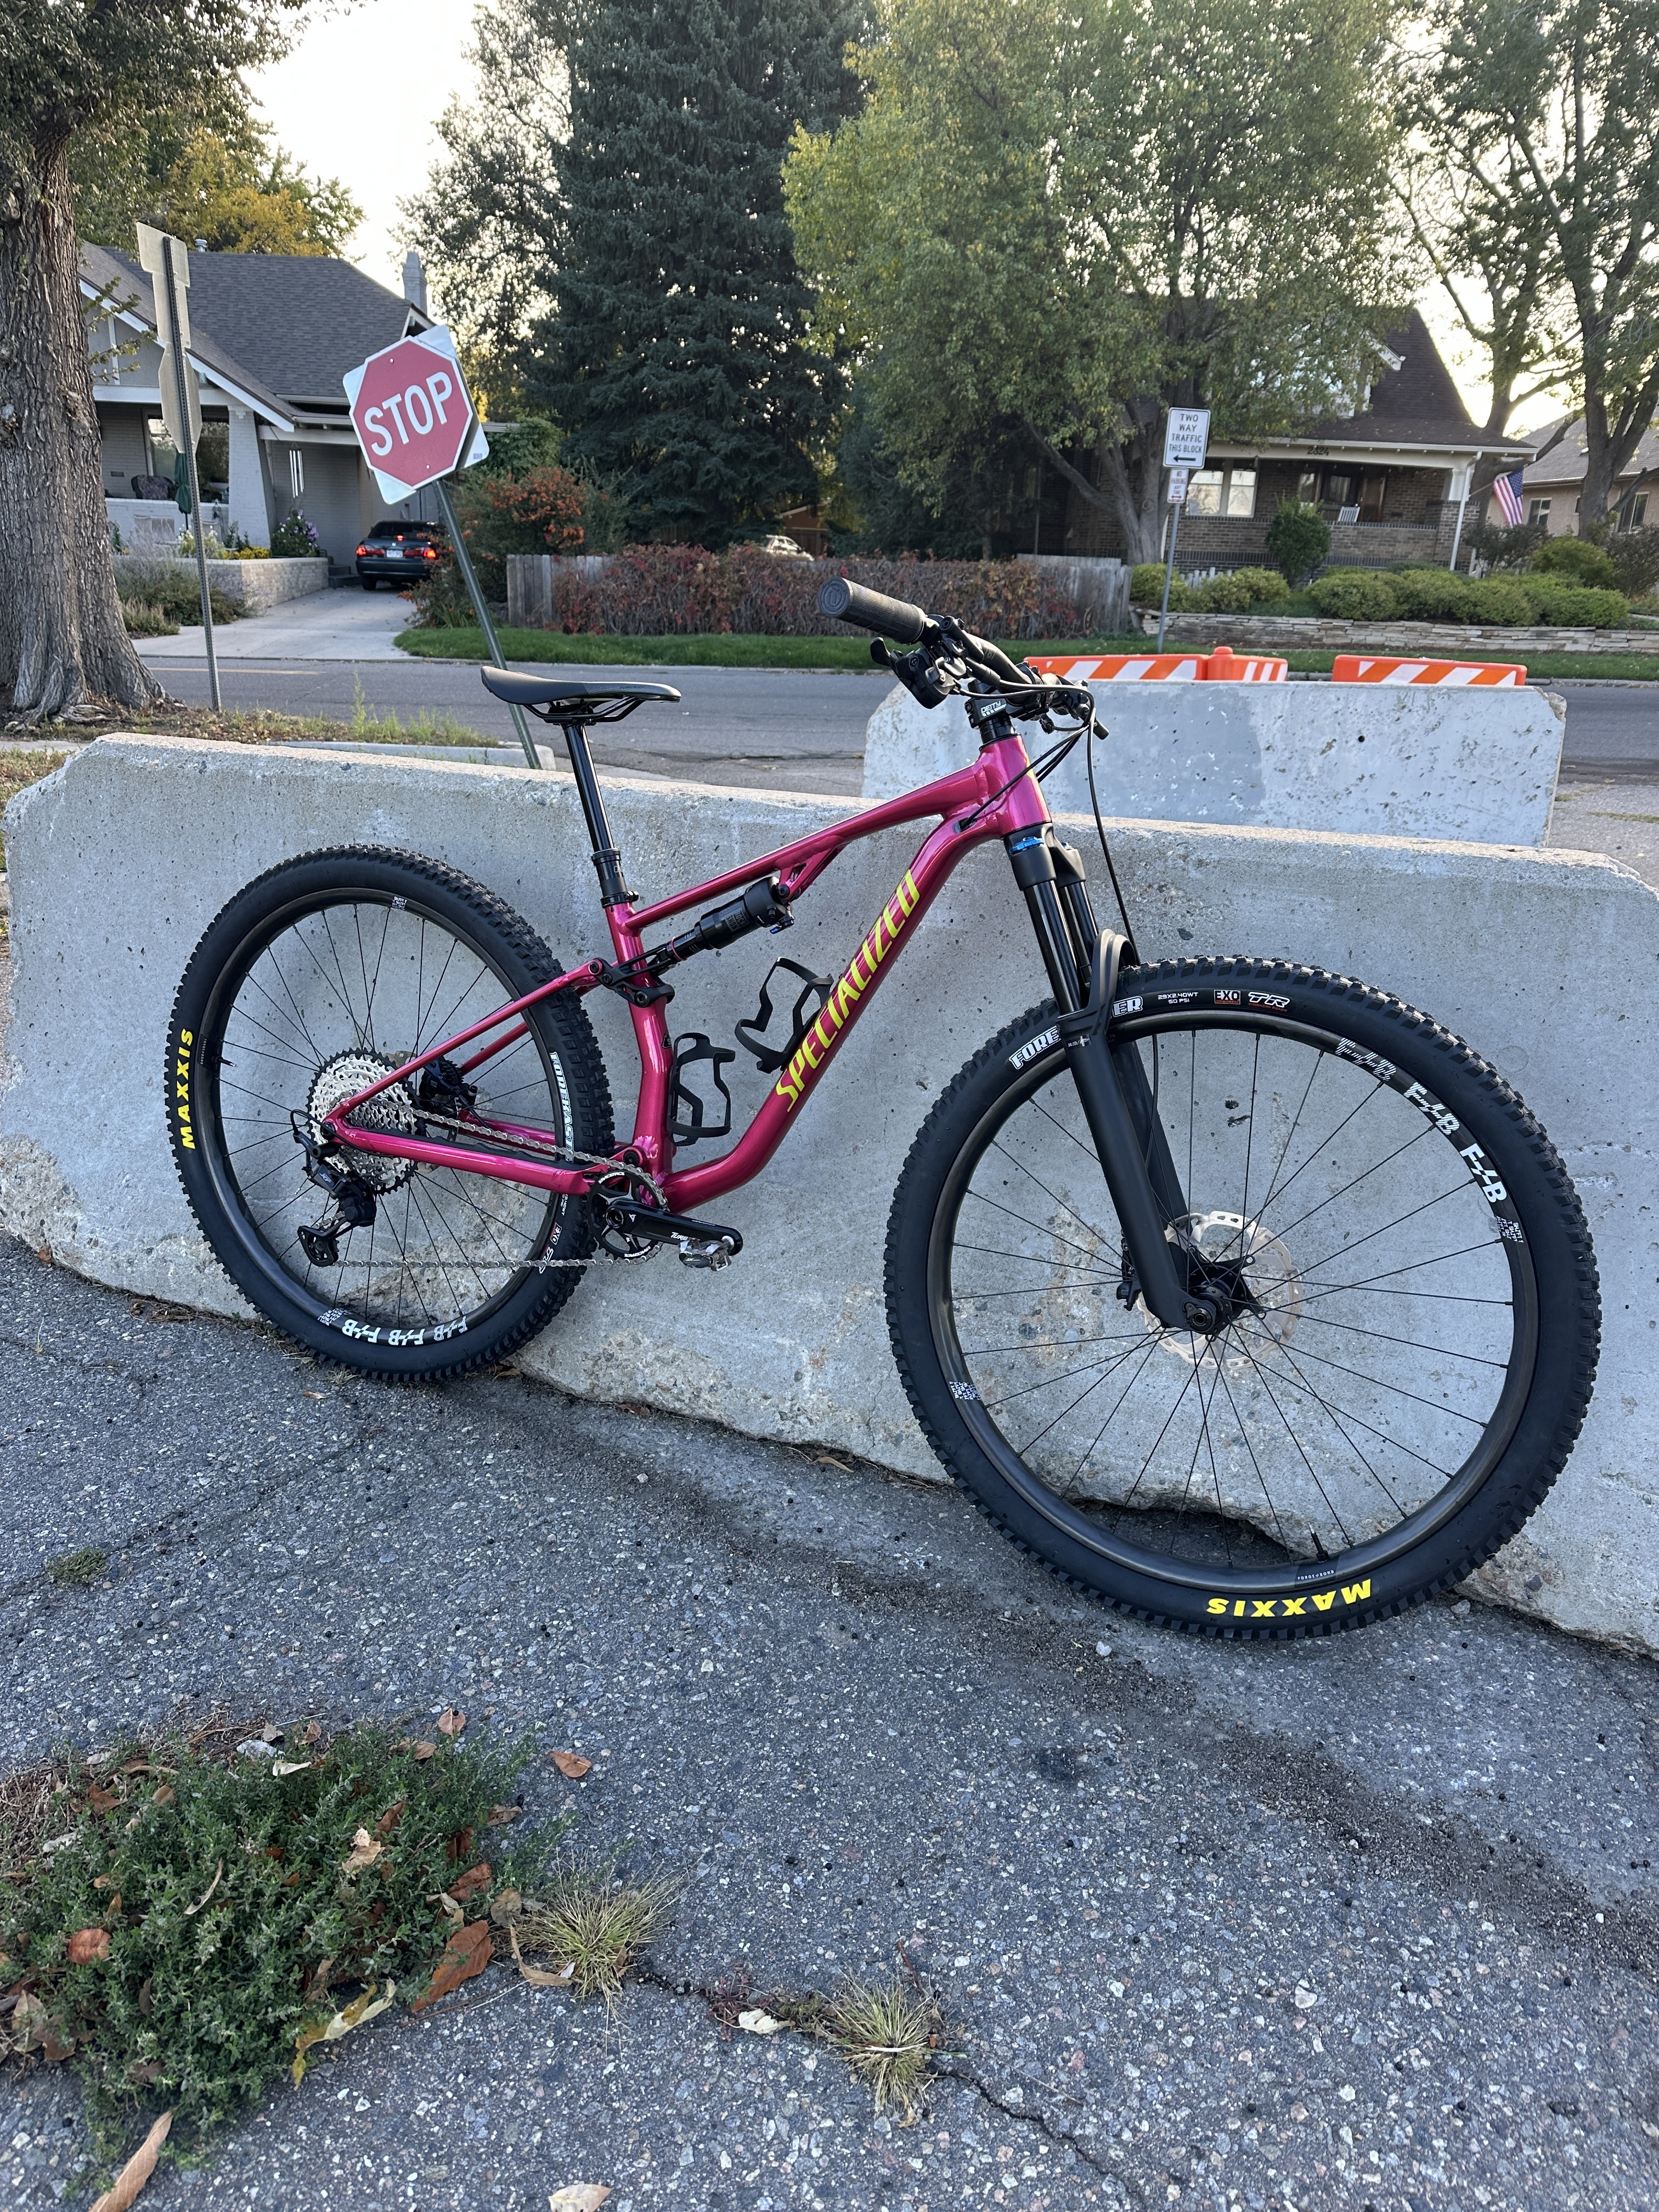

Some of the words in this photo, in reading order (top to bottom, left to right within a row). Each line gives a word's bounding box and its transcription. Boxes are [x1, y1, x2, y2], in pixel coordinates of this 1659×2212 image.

[364, 371, 452, 456] STOP
[1180, 413, 1199, 422] TWO
[1179, 424, 1198, 432] WAY
[1171, 433, 1203, 443] TRAFFIC
[1169, 443, 1182, 453] THIS
[1183, 445, 1203, 454] BLOCK
[980, 700, 1001, 713] DEITY
[776, 869, 920, 1113] SPECIALIZED
[1215, 990, 1240, 1001] EXO
[1248, 992, 1290, 1008] TR
[177, 1028, 196, 1149] MAXXIS
[552, 1225, 562, 1244] EXO
[1206, 1578, 1371, 1618] MAXXIS
